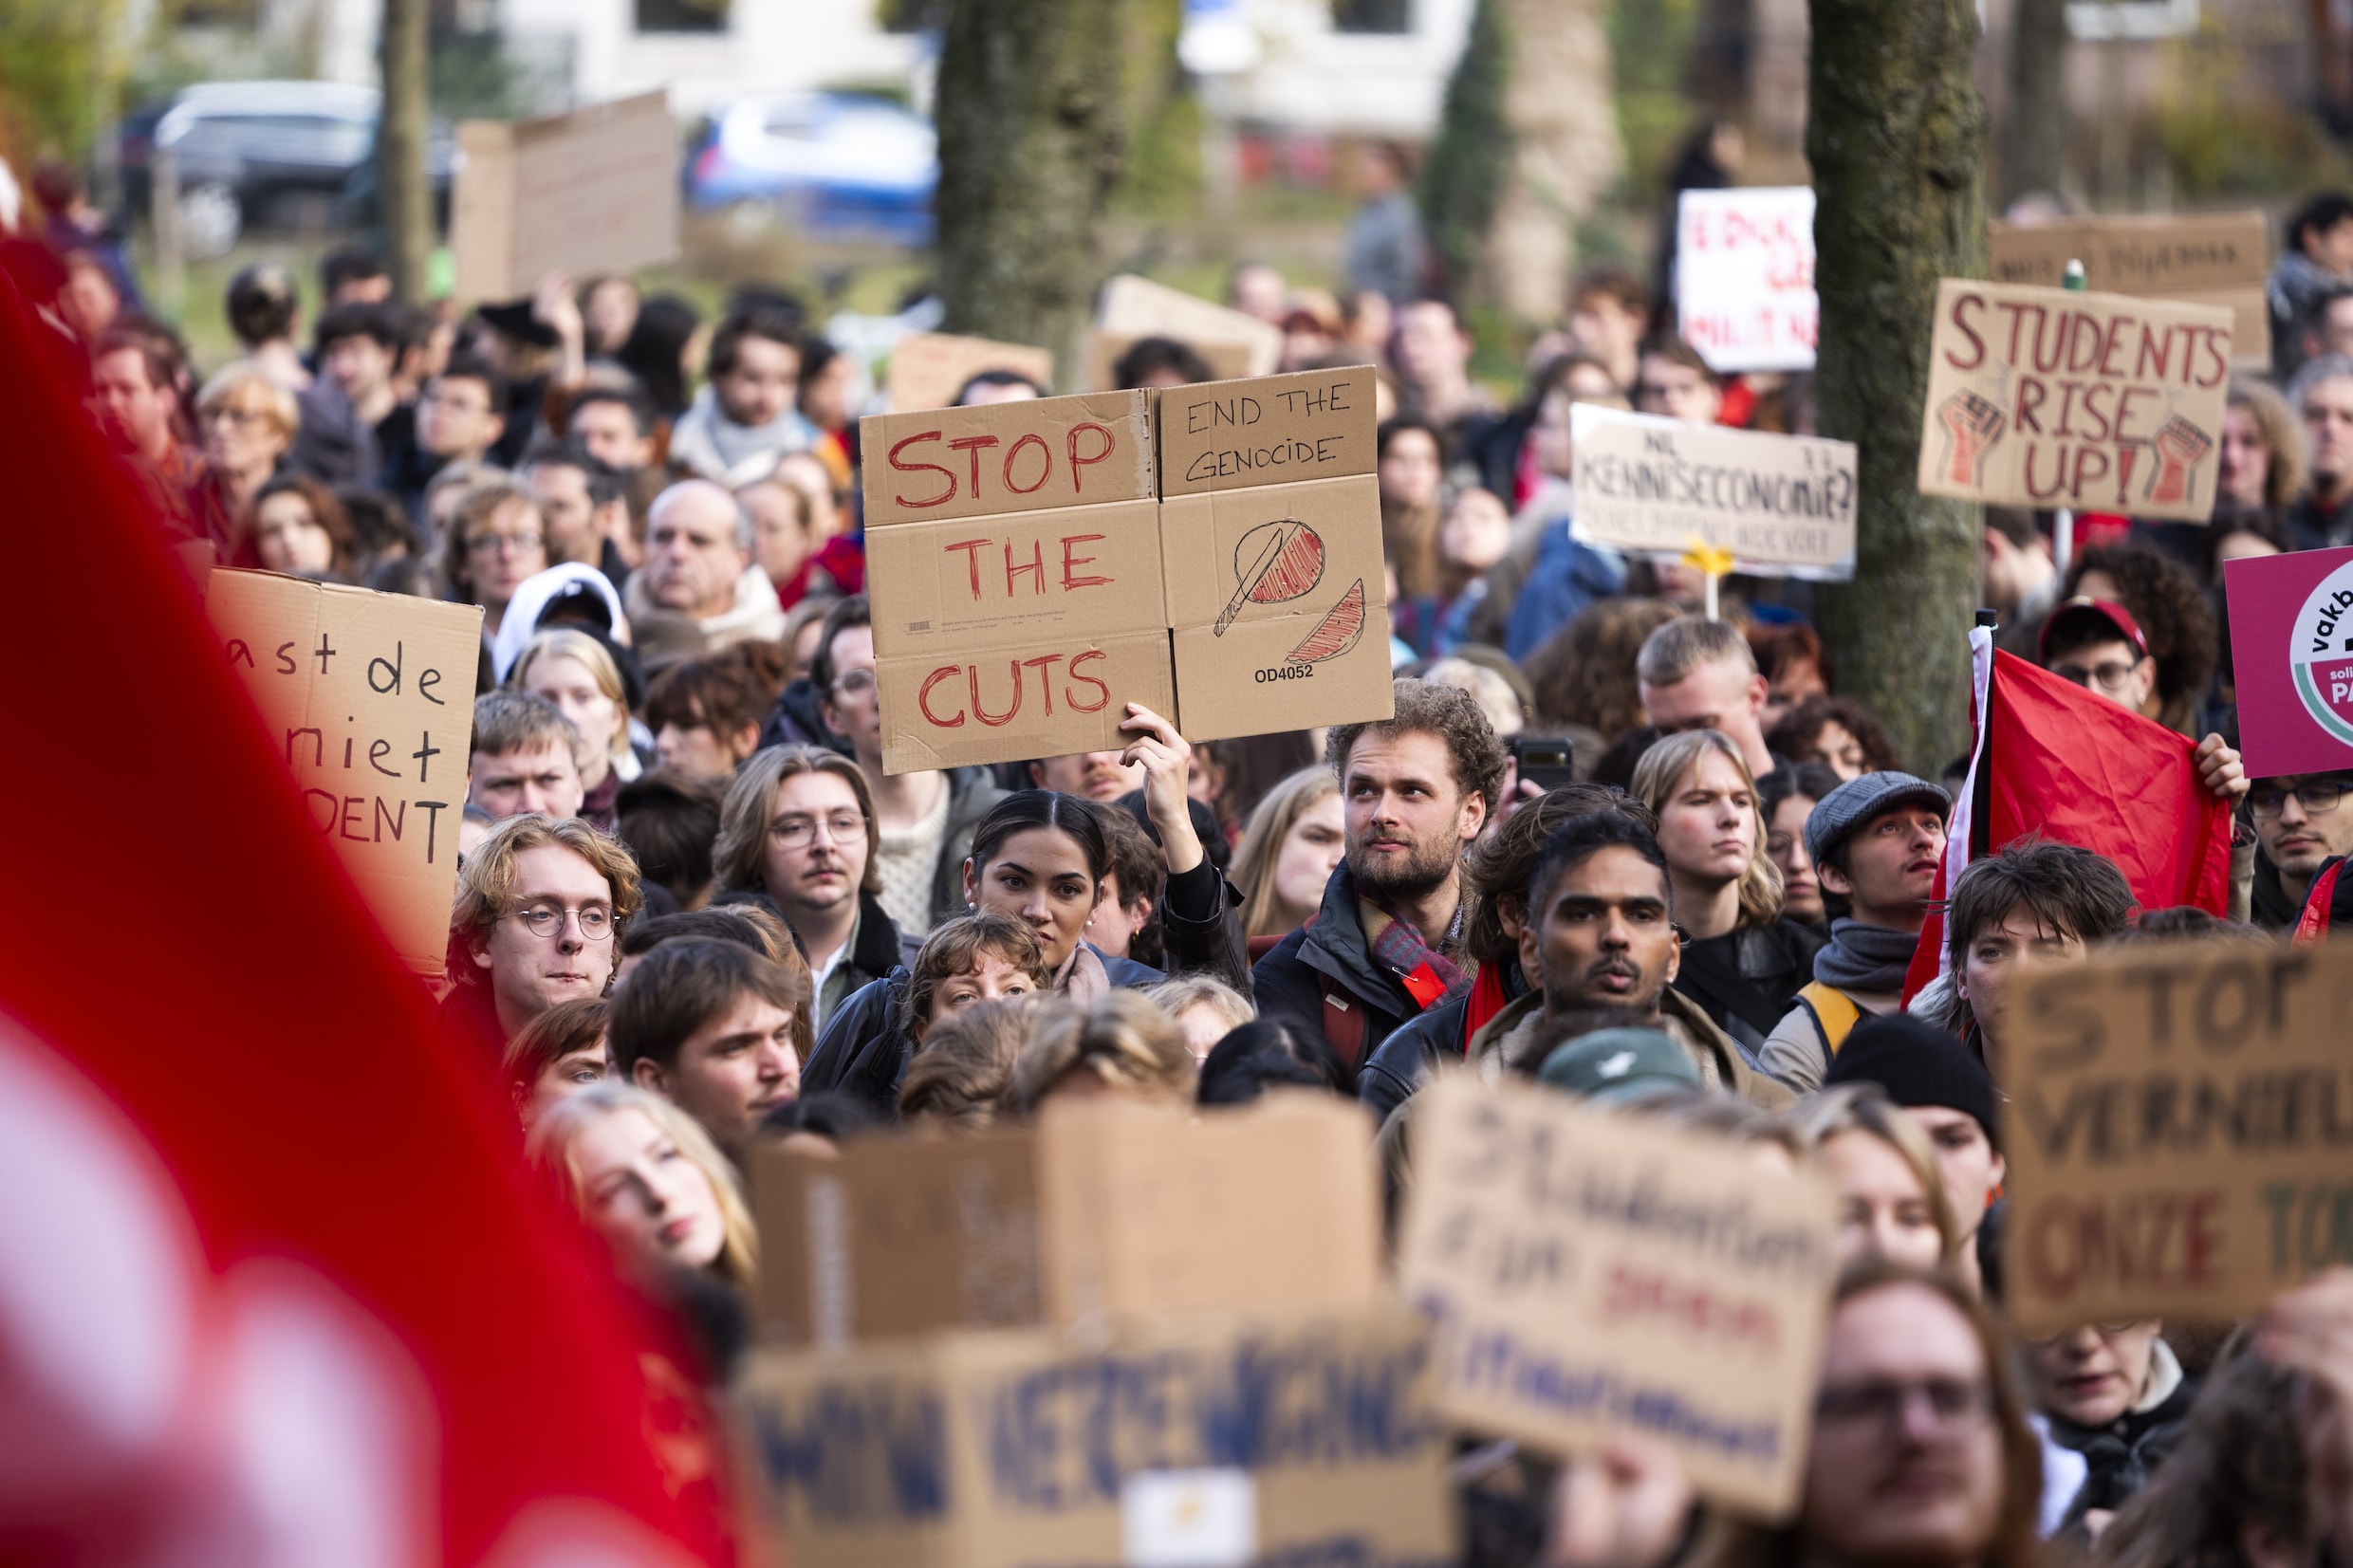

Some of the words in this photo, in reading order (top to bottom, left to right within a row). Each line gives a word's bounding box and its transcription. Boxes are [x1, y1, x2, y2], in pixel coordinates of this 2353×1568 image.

[1944, 293, 2230, 388] STUDENTS
[1188, 397, 1261, 434] END
[1276, 383, 1350, 417] THE
[2014, 375, 2160, 445] RISE
[888, 422, 1116, 508] STOP
[2026, 442, 2137, 506] UP!
[944, 533, 1116, 601] THE
[368, 640, 445, 706] de
[918, 650, 1110, 728] CUTS
[1254, 664, 1313, 683] OD4052
[287, 715, 440, 783] niet
